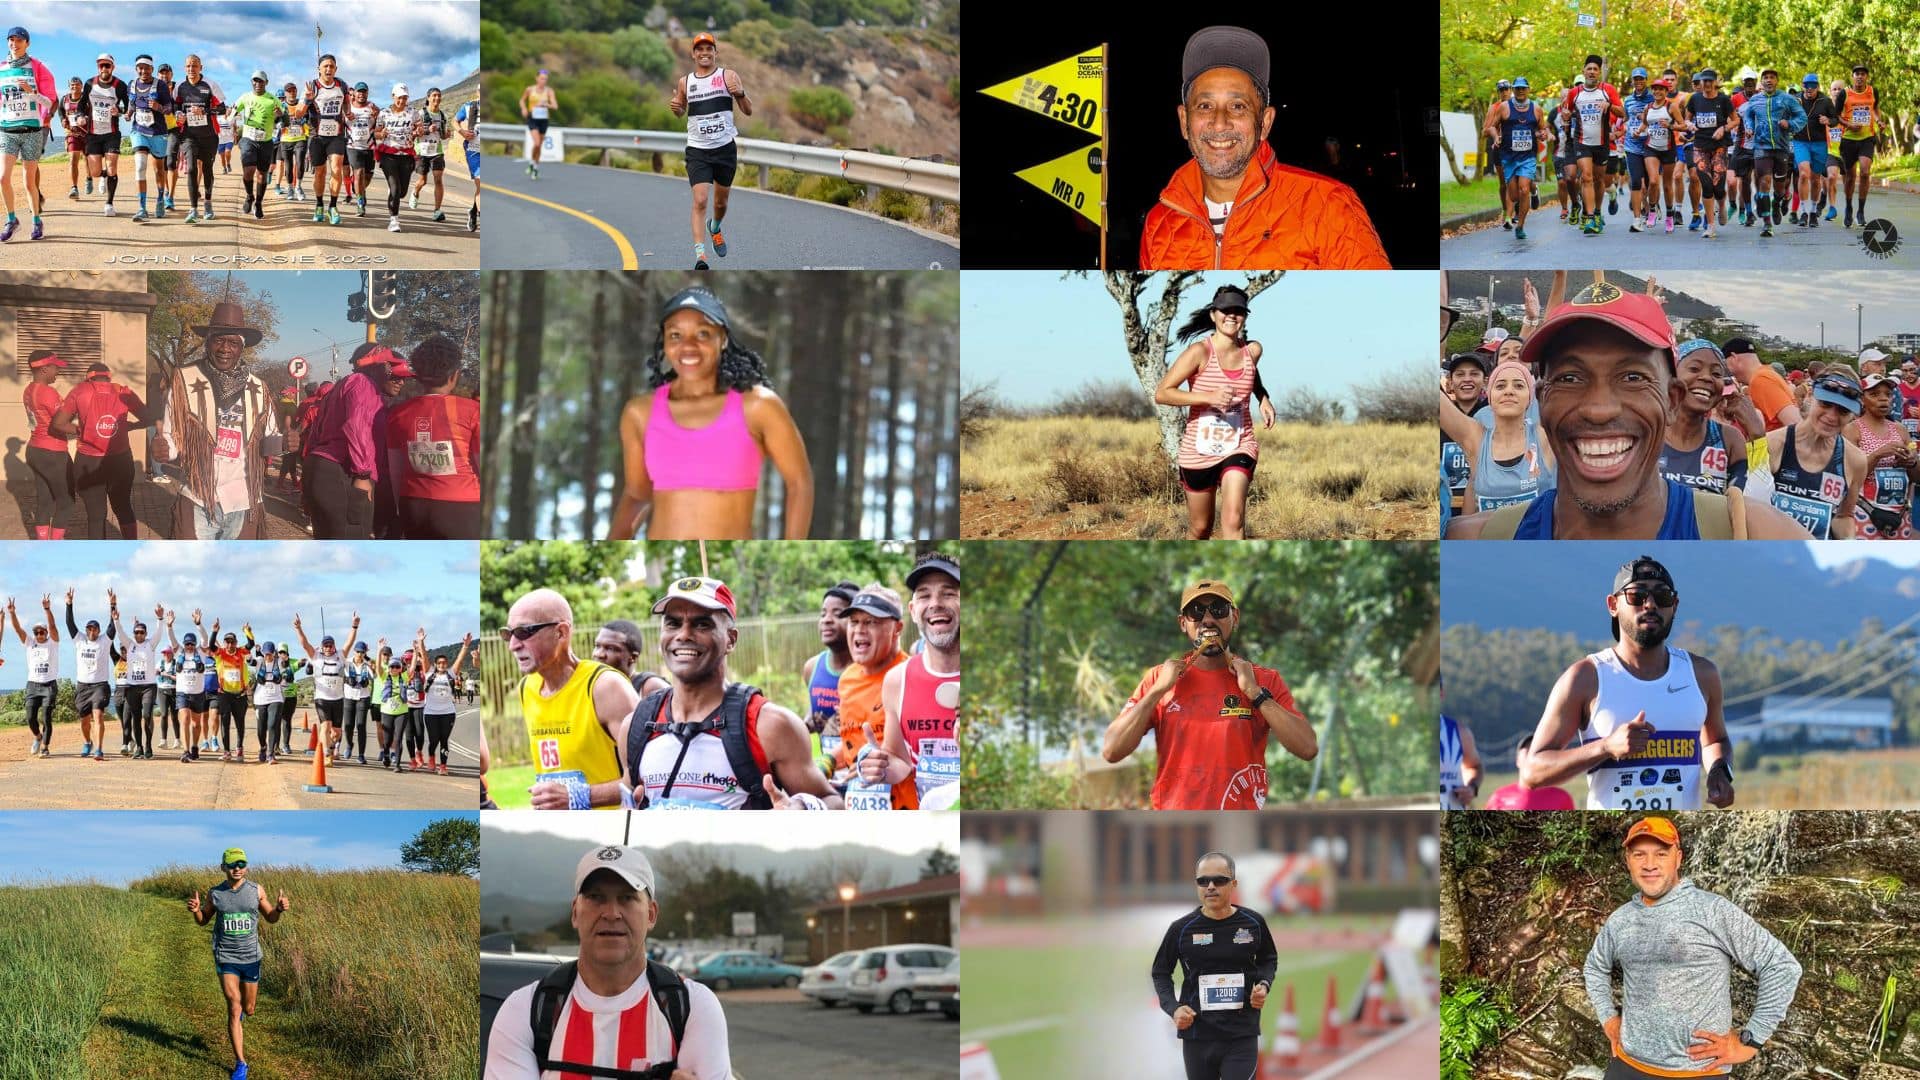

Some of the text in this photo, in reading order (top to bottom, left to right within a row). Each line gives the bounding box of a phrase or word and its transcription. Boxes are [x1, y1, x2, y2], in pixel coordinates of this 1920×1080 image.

[711, 76, 722, 87] 40
[387, 121, 409, 129] MLH
[700, 123, 725, 135] 5625
[1052, 177, 1074, 203] MR
[295, 362, 303, 374] P
[1202, 427, 1235, 442] 152
[1703, 449, 1727, 472] 45
[1682, 474, 1724, 488] ZONE
[1884, 478, 1904, 490] 8160
[1776, 482, 1820, 497] RUN Z
[1824, 478, 1842, 499] 65
[1792, 502, 1825, 516] Sanlam
[907, 720, 939, 731] WEST
[542, 741, 559, 767] 65
[225, 920, 250, 930] 1096
